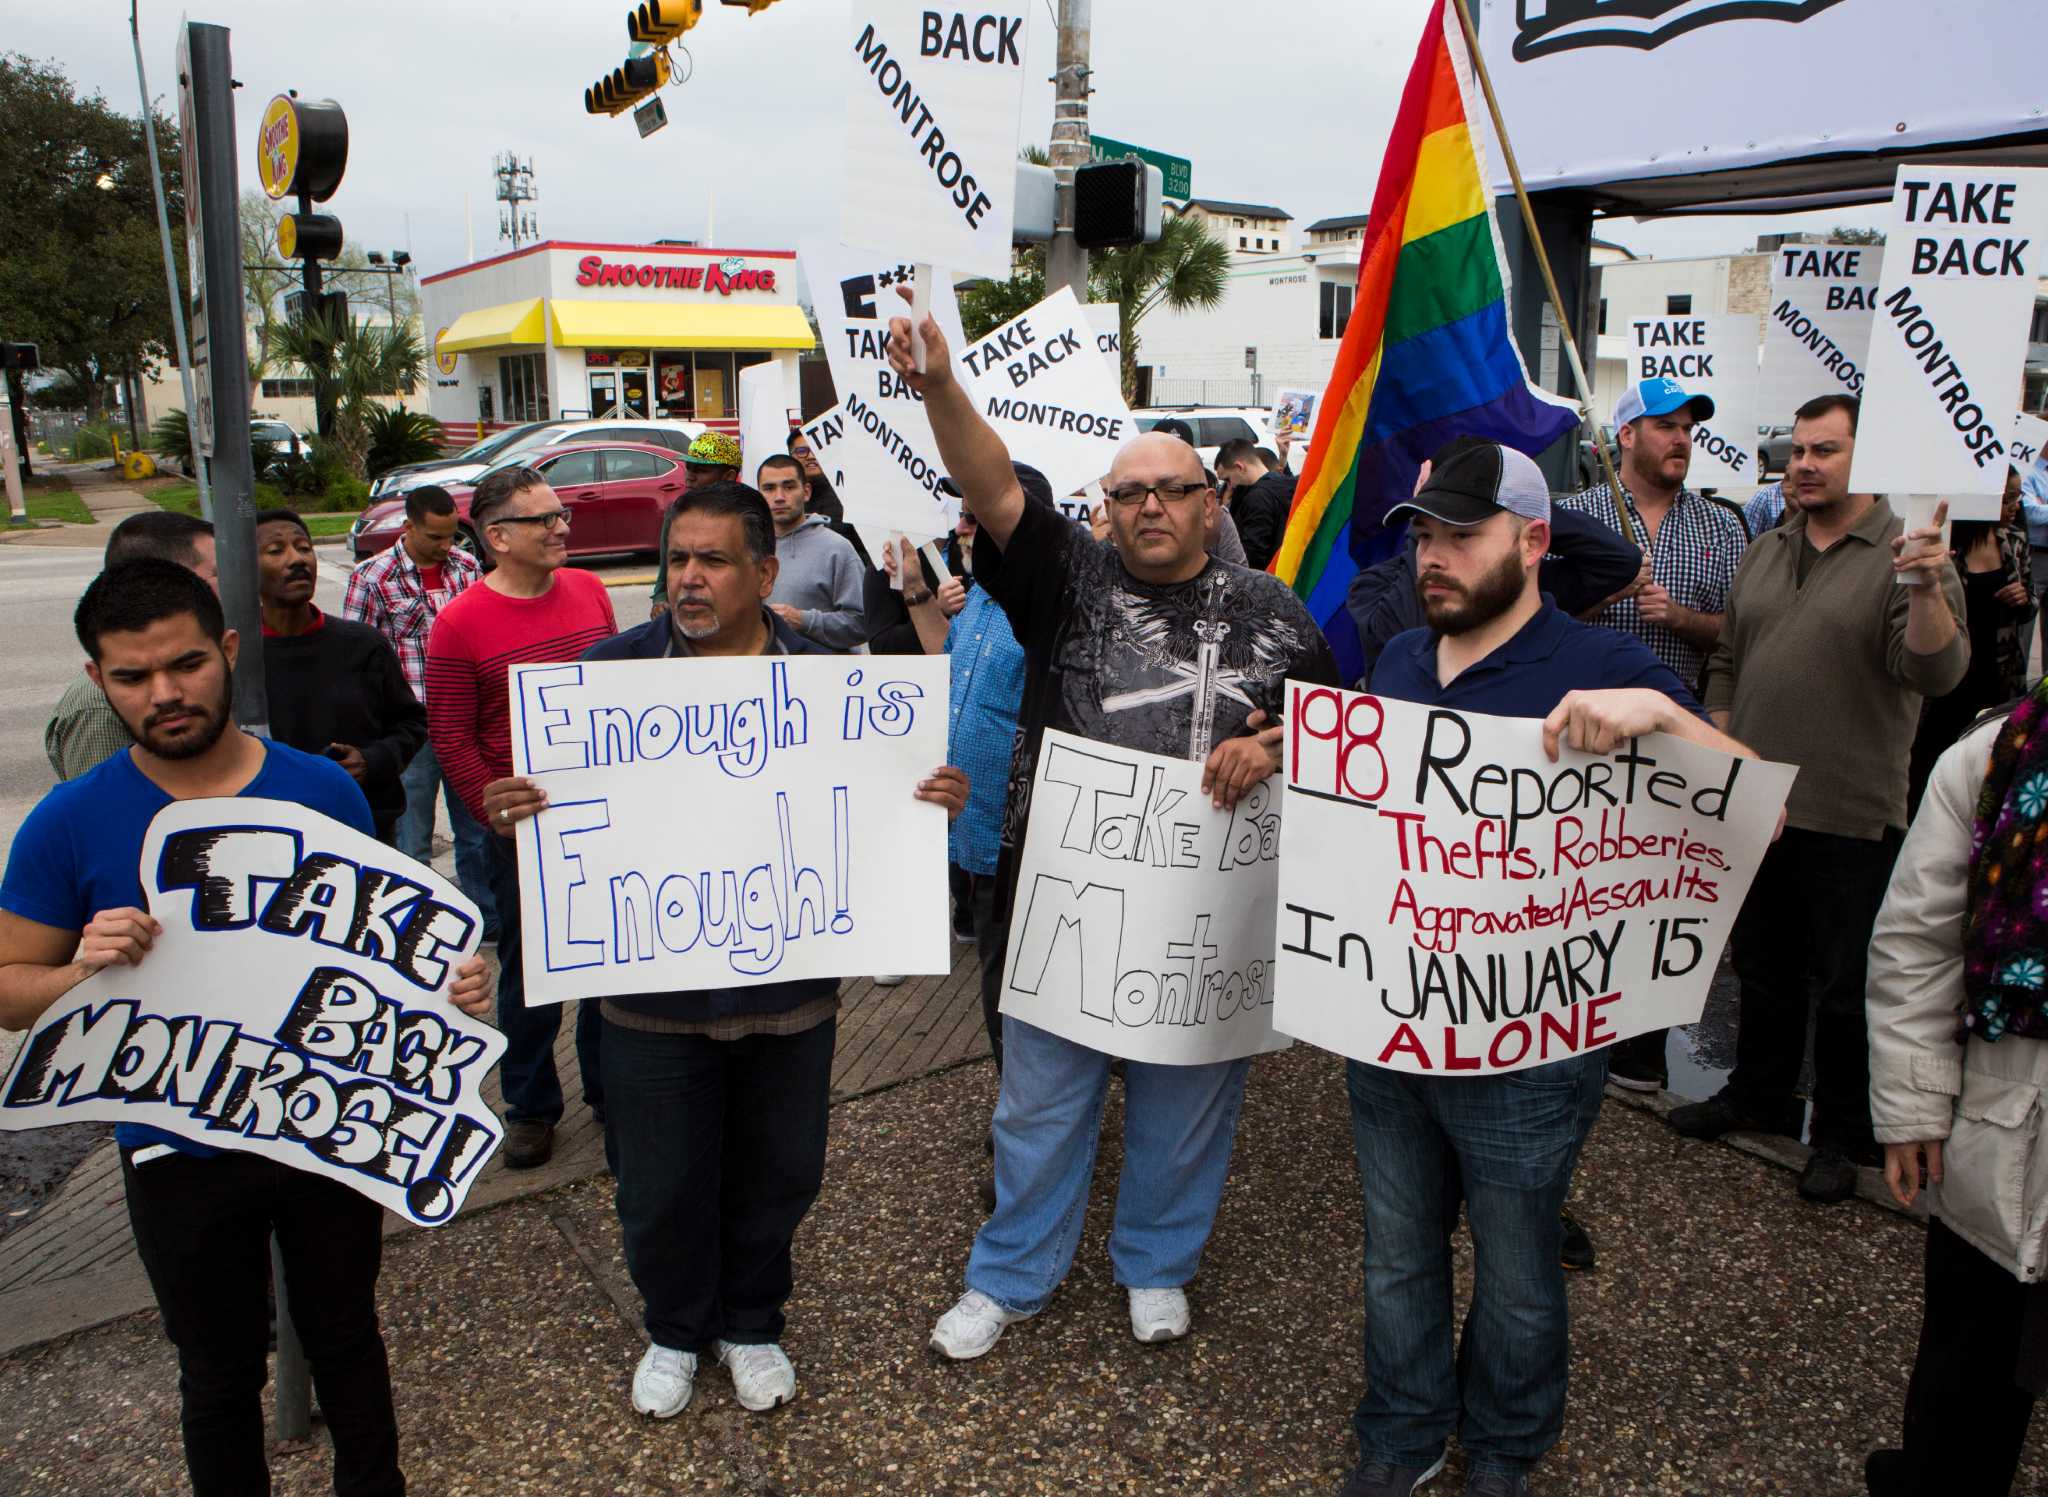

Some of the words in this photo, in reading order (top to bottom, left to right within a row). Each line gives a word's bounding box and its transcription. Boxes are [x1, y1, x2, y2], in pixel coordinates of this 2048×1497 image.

[920, 11, 1022, 66] BACK
[855, 23, 992, 230] MONTROSE
[1167, 178, 1189, 194] 3200
[1170, 162, 1188, 178] BLVD
[1902, 181, 2017, 224] TAKE
[576, 256, 705, 289] SMOOTHIE
[704, 262, 776, 296] KING
[1269, 274, 1307, 286] MONTROSE
[1782, 250, 1861, 278] TAKE
[1911, 238, 2030, 276] BACK
[1826, 286, 1878, 311] BAC
[845, 328, 891, 360] TAK
[961, 318, 1036, 378] TAKE
[1007, 328, 1081, 388] BACK
[1097, 333, 1120, 352] CK
[1633, 321, 1706, 347] TAKE
[1773, 299, 1865, 396] MONTROS
[1641, 354, 1714, 378] BACK
[1884, 286, 2005, 468] MONTROSE
[846, 393, 943, 501] MONTROSE
[987, 397, 1123, 441] MONTROSE
[1693, 421, 1748, 472] ROSE
[2010, 441, 2037, 463] CK
[518, 662, 808, 778] Enough
[843, 669, 924, 740] is
[1293, 687, 1389, 802] 198
[1218, 780, 1282, 871] Ba
[1378, 809, 1546, 880] Thefts,
[1553, 807, 1732, 877] Robberies,
[156, 825, 476, 991] TAKE
[533, 786, 854, 976] Enough!
[1388, 878, 1567, 953] Aggravated
[1562, 864, 1719, 930] Assaults
[1282, 903, 1373, 981] In
[1381, 919, 1625, 1025] JANUARY
[274, 966, 487, 1105] BACK
[1377, 991, 1622, 1071] ALONE
